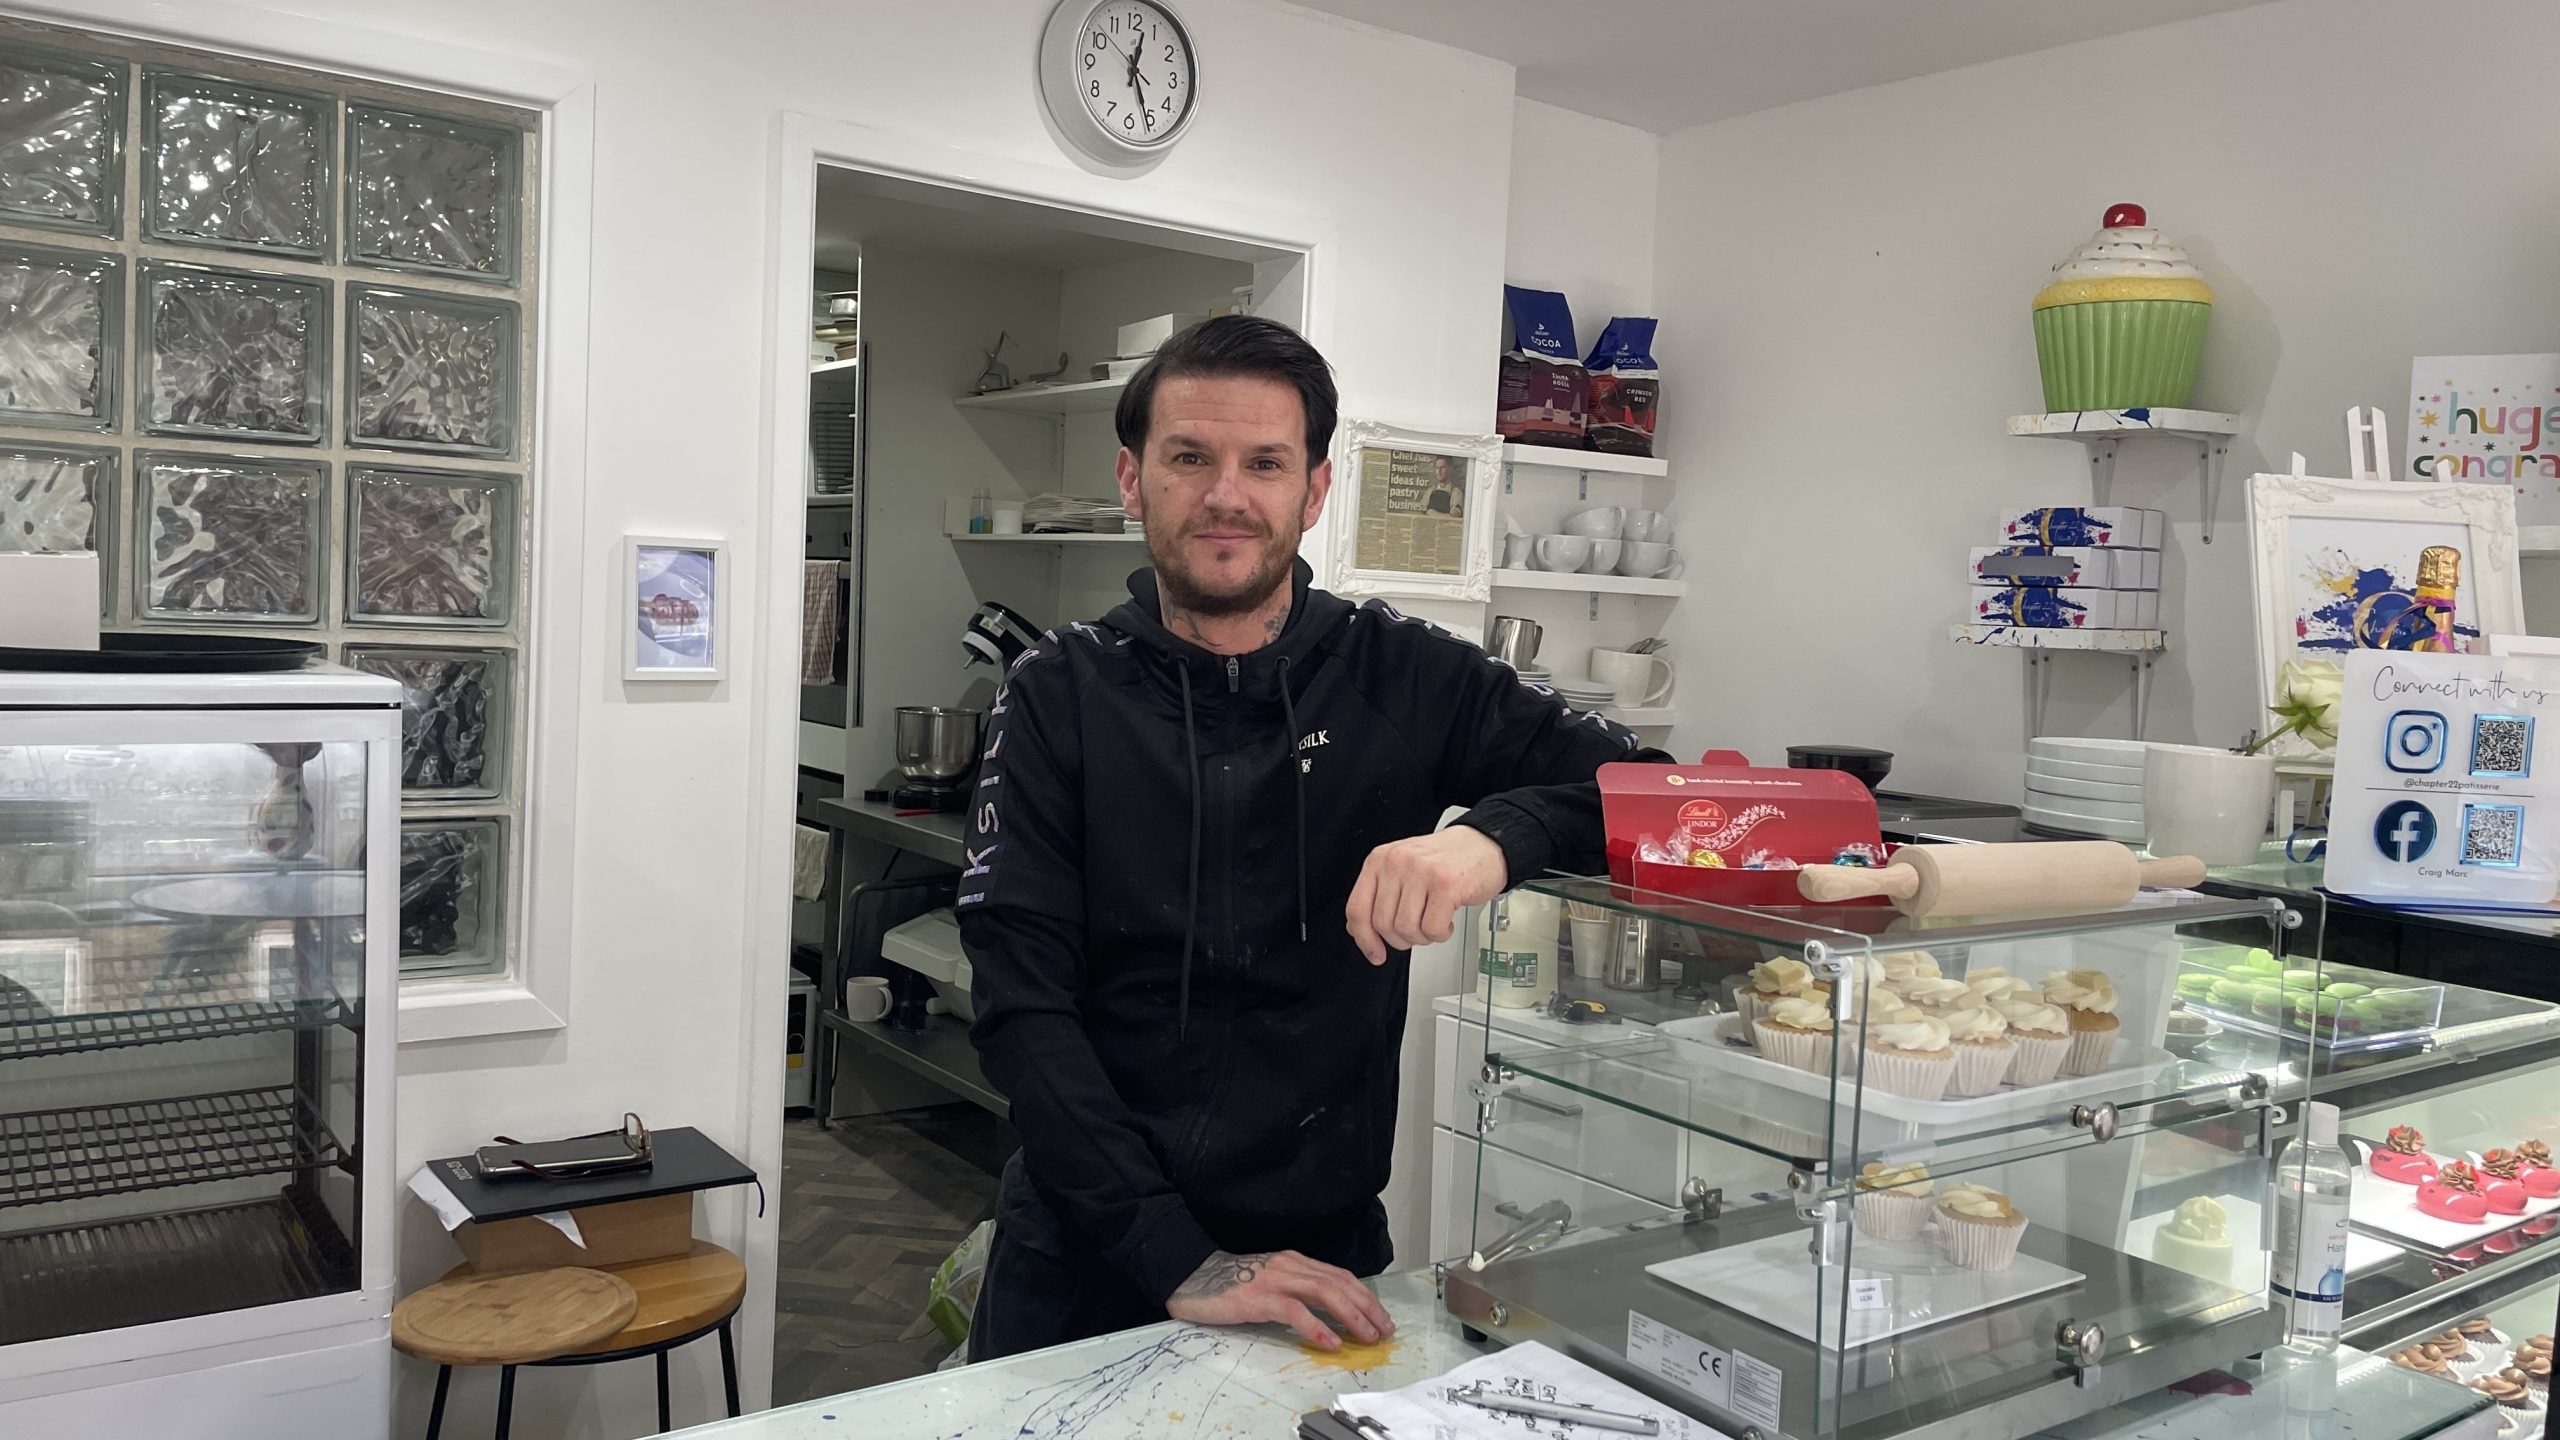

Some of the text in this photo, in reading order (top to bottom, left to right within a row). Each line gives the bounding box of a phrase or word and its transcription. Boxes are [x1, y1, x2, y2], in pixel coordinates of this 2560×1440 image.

[1110, 15, 1119, 34] 11
[1128, 12, 1142, 32] 12
[1092, 31, 1107, 50] 10
[1152, 24, 1157, 41] 1
[1084, 53, 1096, 70] 9
[1164, 45, 1174, 63] 2
[1090, 80, 1100, 98] 8
[1168, 72, 1177, 89] 3
[1107, 101, 1117, 117] 7
[1161, 96, 1171, 113] 4
[1123, 113, 1135, 130] 6
[1145, 109, 1155, 127] 5
[1530, 335, 1561, 348] COCOA
[2448, 392, 2560, 451] huge
[1391, 463, 1418, 473] sweet
[1390, 474, 1430, 487] ideas for
[1389, 488, 1420, 501] pastry
[1388, 499, 1428, 511] business
[2374, 665, 2549, 705] Connect with us
[2404, 777, 2500, 791] @chapter22patisserie
[1687, 820, 1718, 828] LINDOR
[2418, 867, 2468, 878] Craig Marc
[2327, 1243, 2346, 1253] Han
